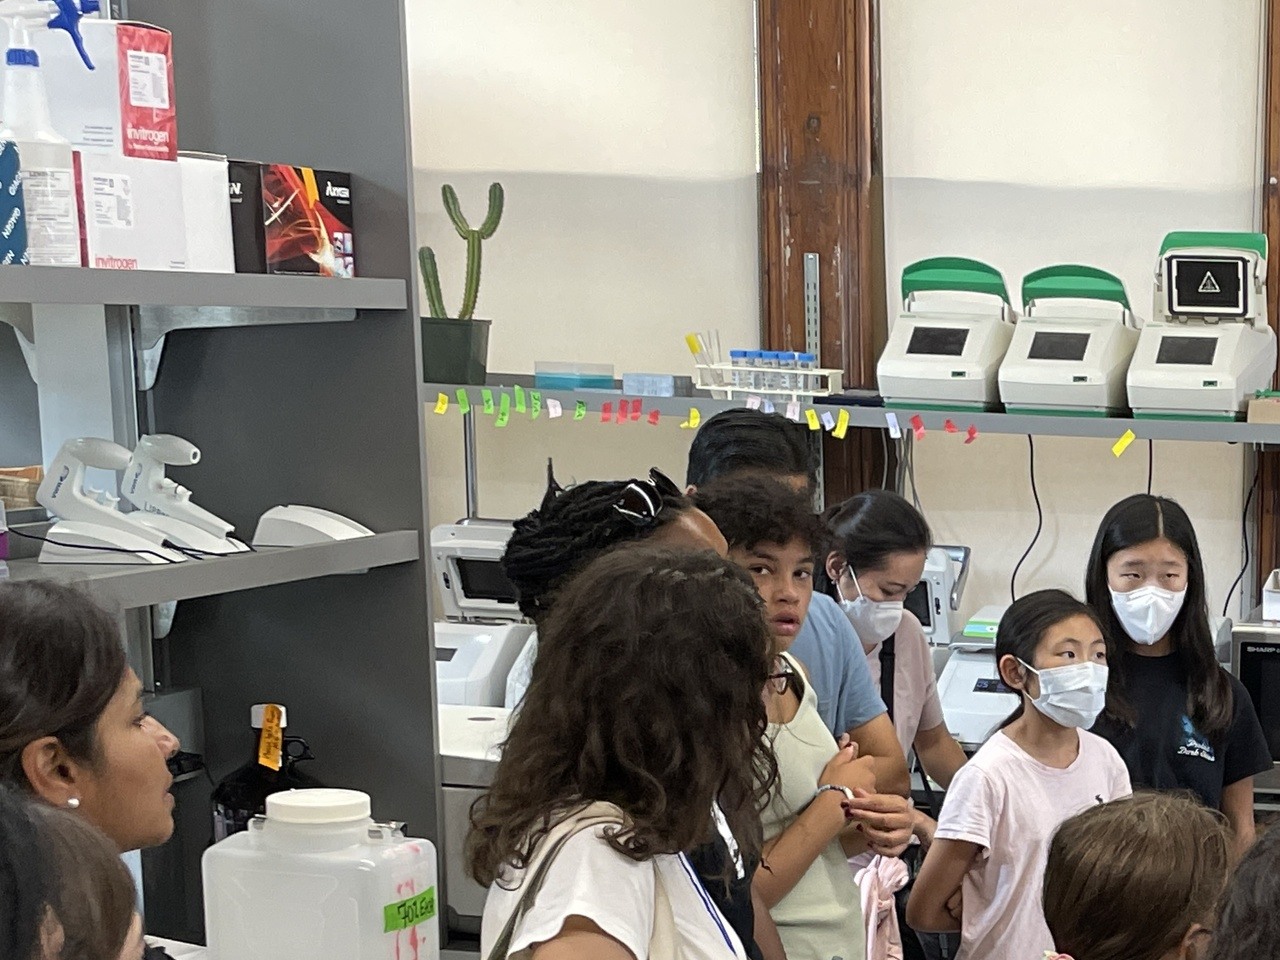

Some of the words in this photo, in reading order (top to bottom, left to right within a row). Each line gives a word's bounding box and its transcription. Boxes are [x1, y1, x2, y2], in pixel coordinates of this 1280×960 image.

[126, 124, 170, 145] invitrogen
[2, 207, 21, 239] QIAGEN
[95, 254, 138, 270] invitrogen
